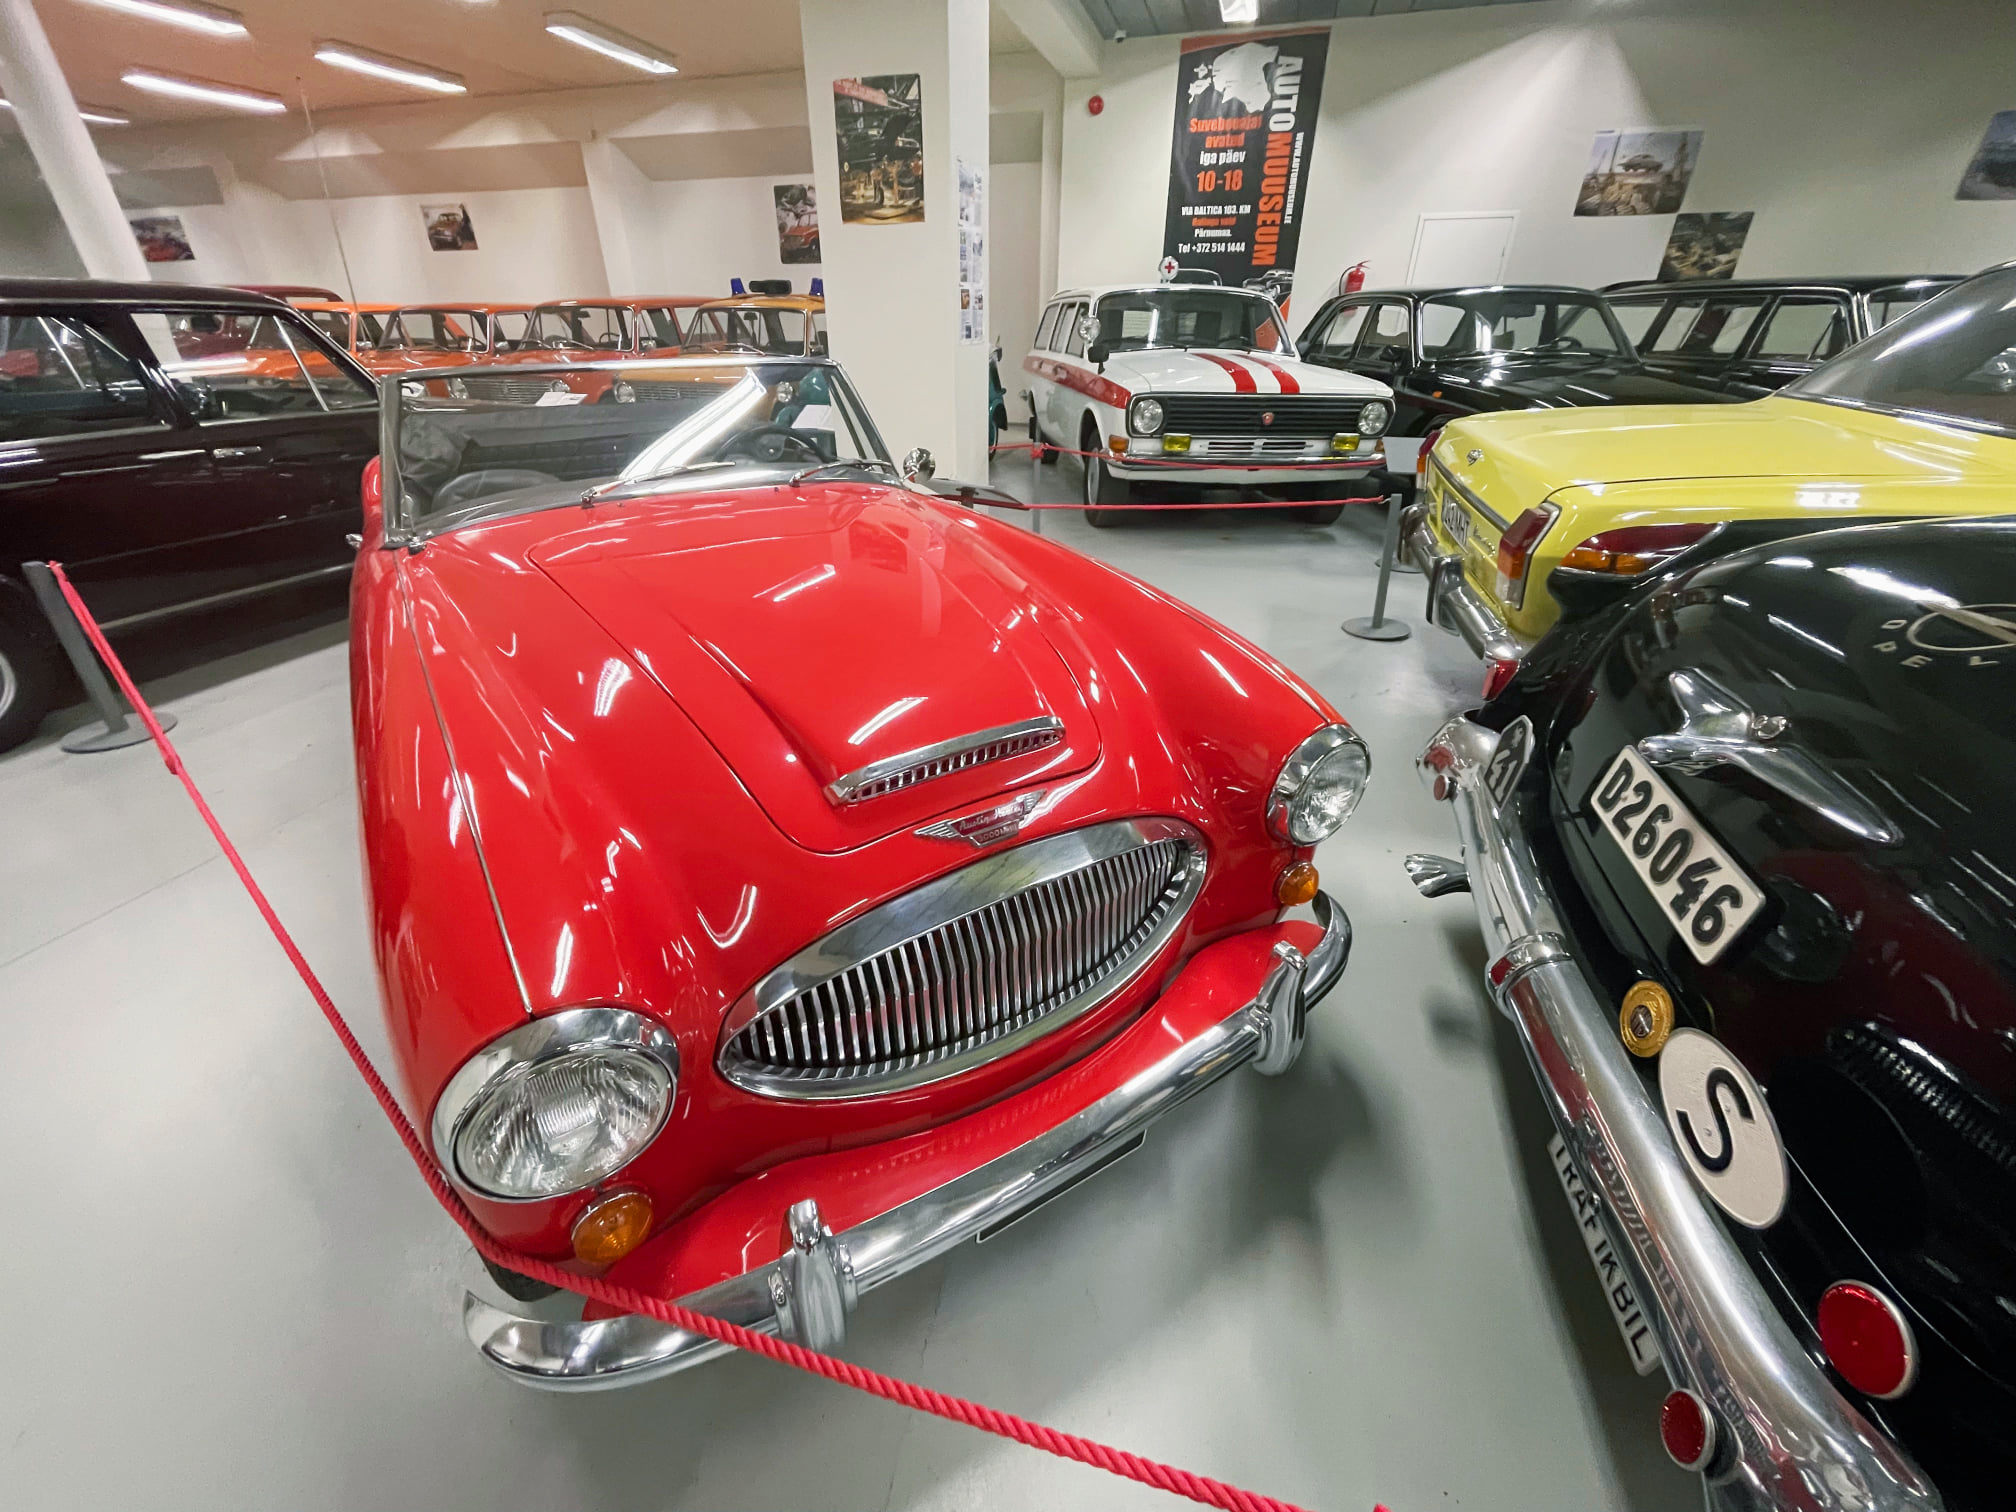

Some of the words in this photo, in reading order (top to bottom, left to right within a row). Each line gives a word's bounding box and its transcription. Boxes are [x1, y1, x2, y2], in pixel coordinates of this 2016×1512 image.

[1218, 149, 1246, 165] päev
[1196, 169, 1243, 192] 10-18
[1181, 206, 1194, 216] VIA
[1194, 205, 1223, 215] BALTICA
[1239, 204, 1251, 214] KM
[1178, 243, 1191, 254] Tel
[1192, 242, 1211, 253] +372
[1211, 242, 1226, 253] 514
[1227, 242, 1246, 252] 1444
[1872, 619, 1999, 669] OPEL
[1597, 758, 1743, 945] D26046
[1676, 1067, 1755, 1173] S
